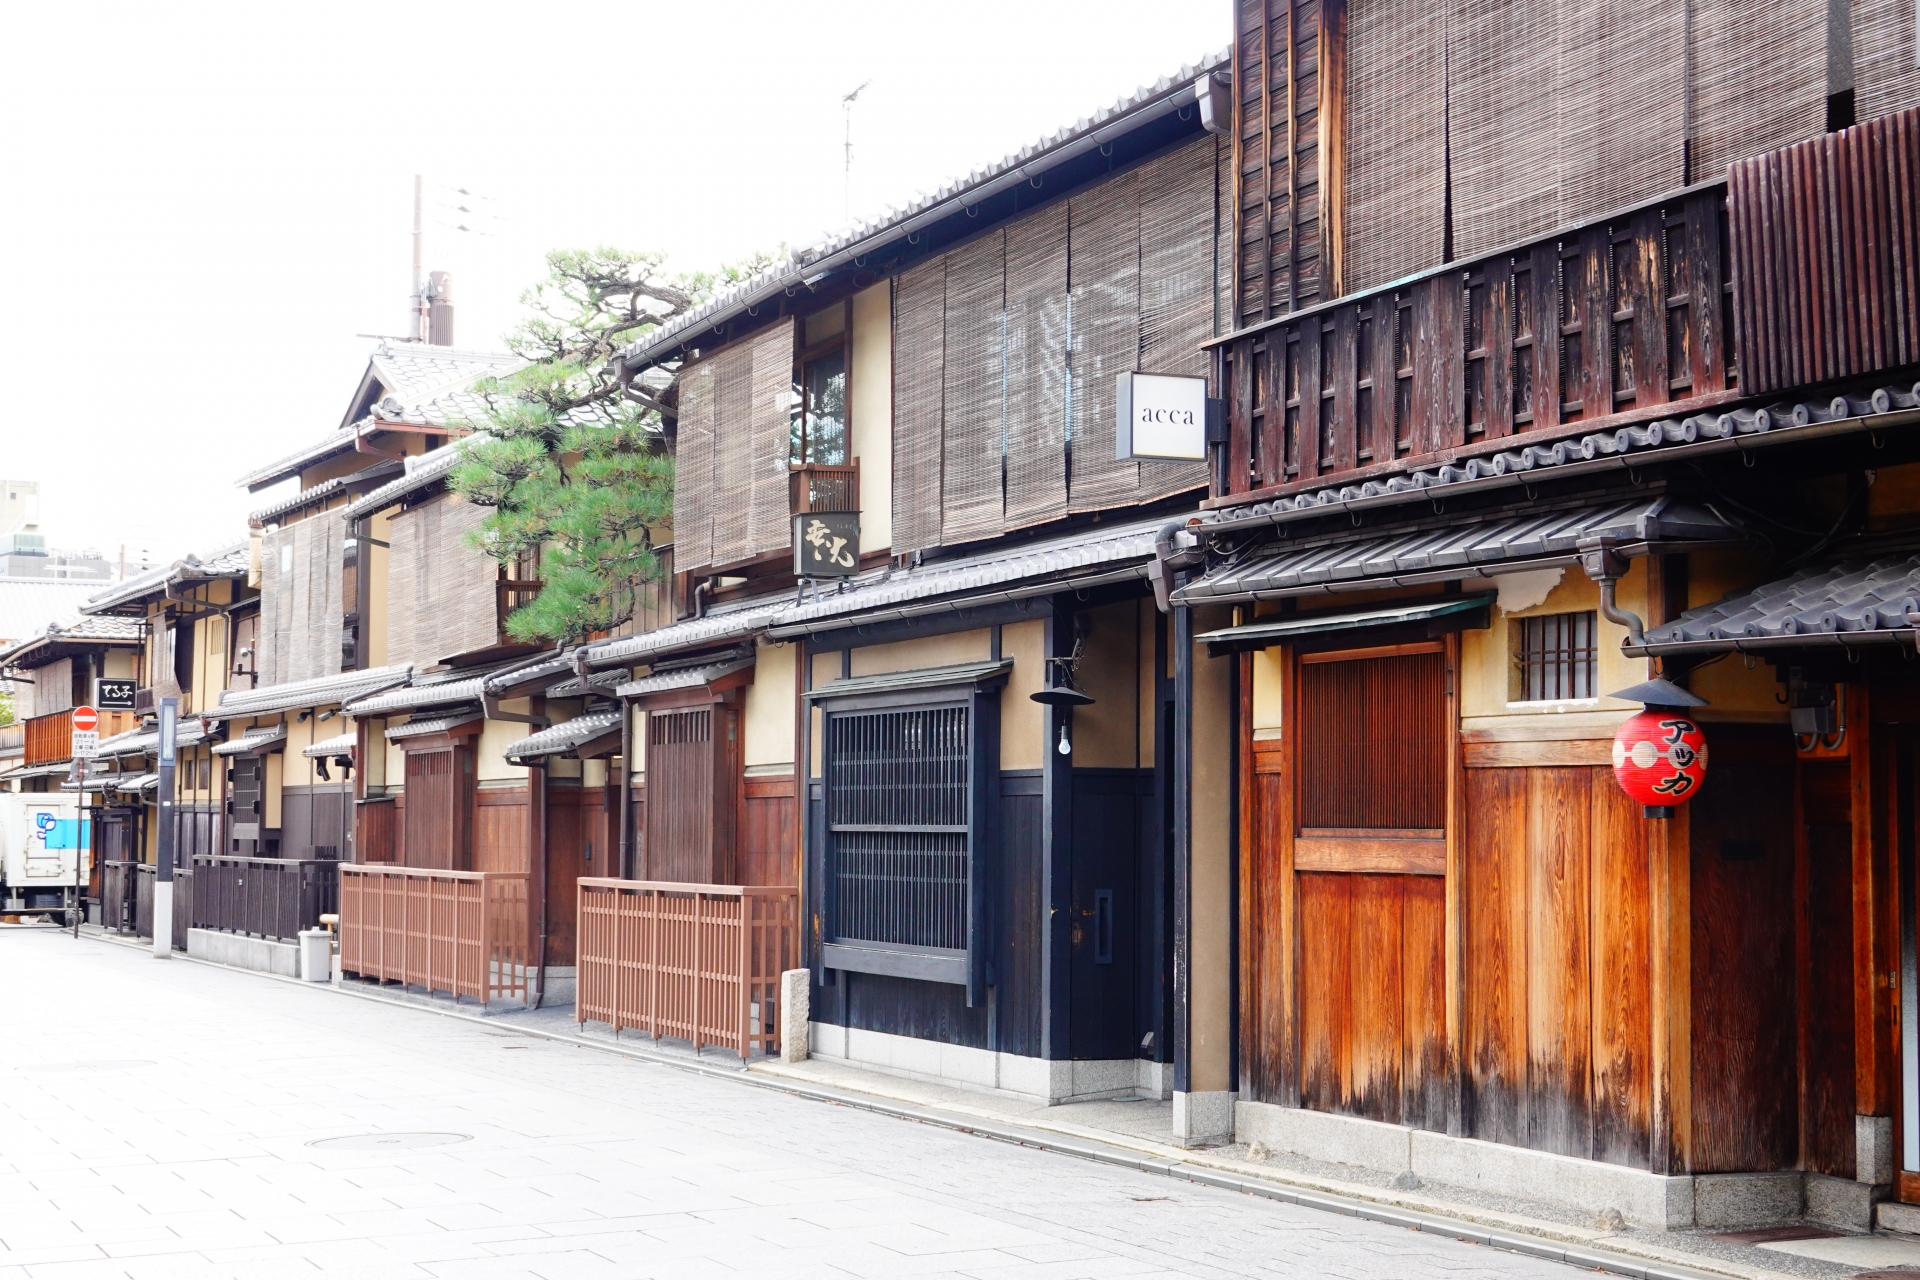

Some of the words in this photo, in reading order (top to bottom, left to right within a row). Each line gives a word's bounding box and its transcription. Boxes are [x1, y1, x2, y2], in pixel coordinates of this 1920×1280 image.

[1142, 407, 1194, 425] acca
[101, 684, 133, 698] てる子
[1652, 720, 1696, 795] アッカ
